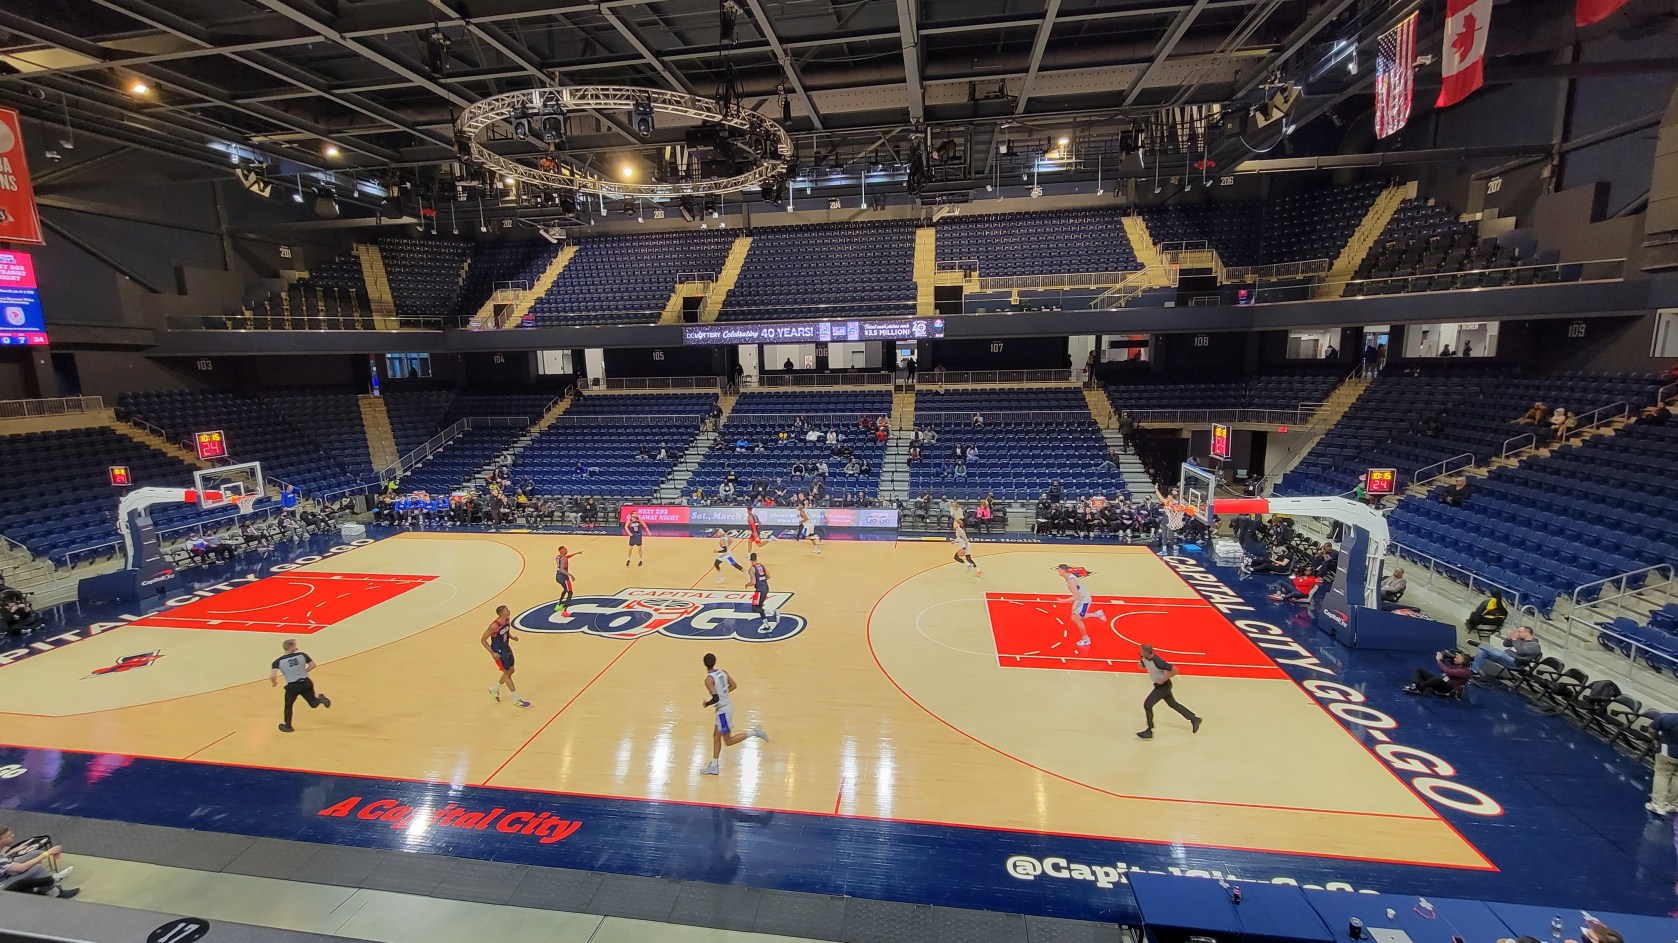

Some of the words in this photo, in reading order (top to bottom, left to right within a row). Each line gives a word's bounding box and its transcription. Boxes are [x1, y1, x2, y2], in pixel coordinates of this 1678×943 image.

[1220, 176, 1233, 185] 206
[502, 220, 512, 228] 202
[761, 328, 775, 337] 40
[777, 327, 814, 337] YEARS!
[1568, 324, 1586, 337] 109
[1194, 336, 1209, 347] 108
[815, 347, 828, 357] 106
[990, 343, 1003, 353] 107
[493, 353, 505, 364] 104
[652, 351, 664, 360] 105
[197, 360, 212, 370] 103
[202, 442, 220, 456] 24
[1372, 480, 1387, 489] 24
[712, 511, 742, 520] March
[164, 573, 260, 607] CITY
[627, 590, 714, 600] CAPITAL
[1162, 555, 1256, 614] CAPITAL
[1234, 618, 1338, 676] CITY
[1302, 679, 1504, 817] GO-GO
[317, 796, 363, 817] A
[495, 811, 583, 844] City
[156, 922, 201, 943] 17
